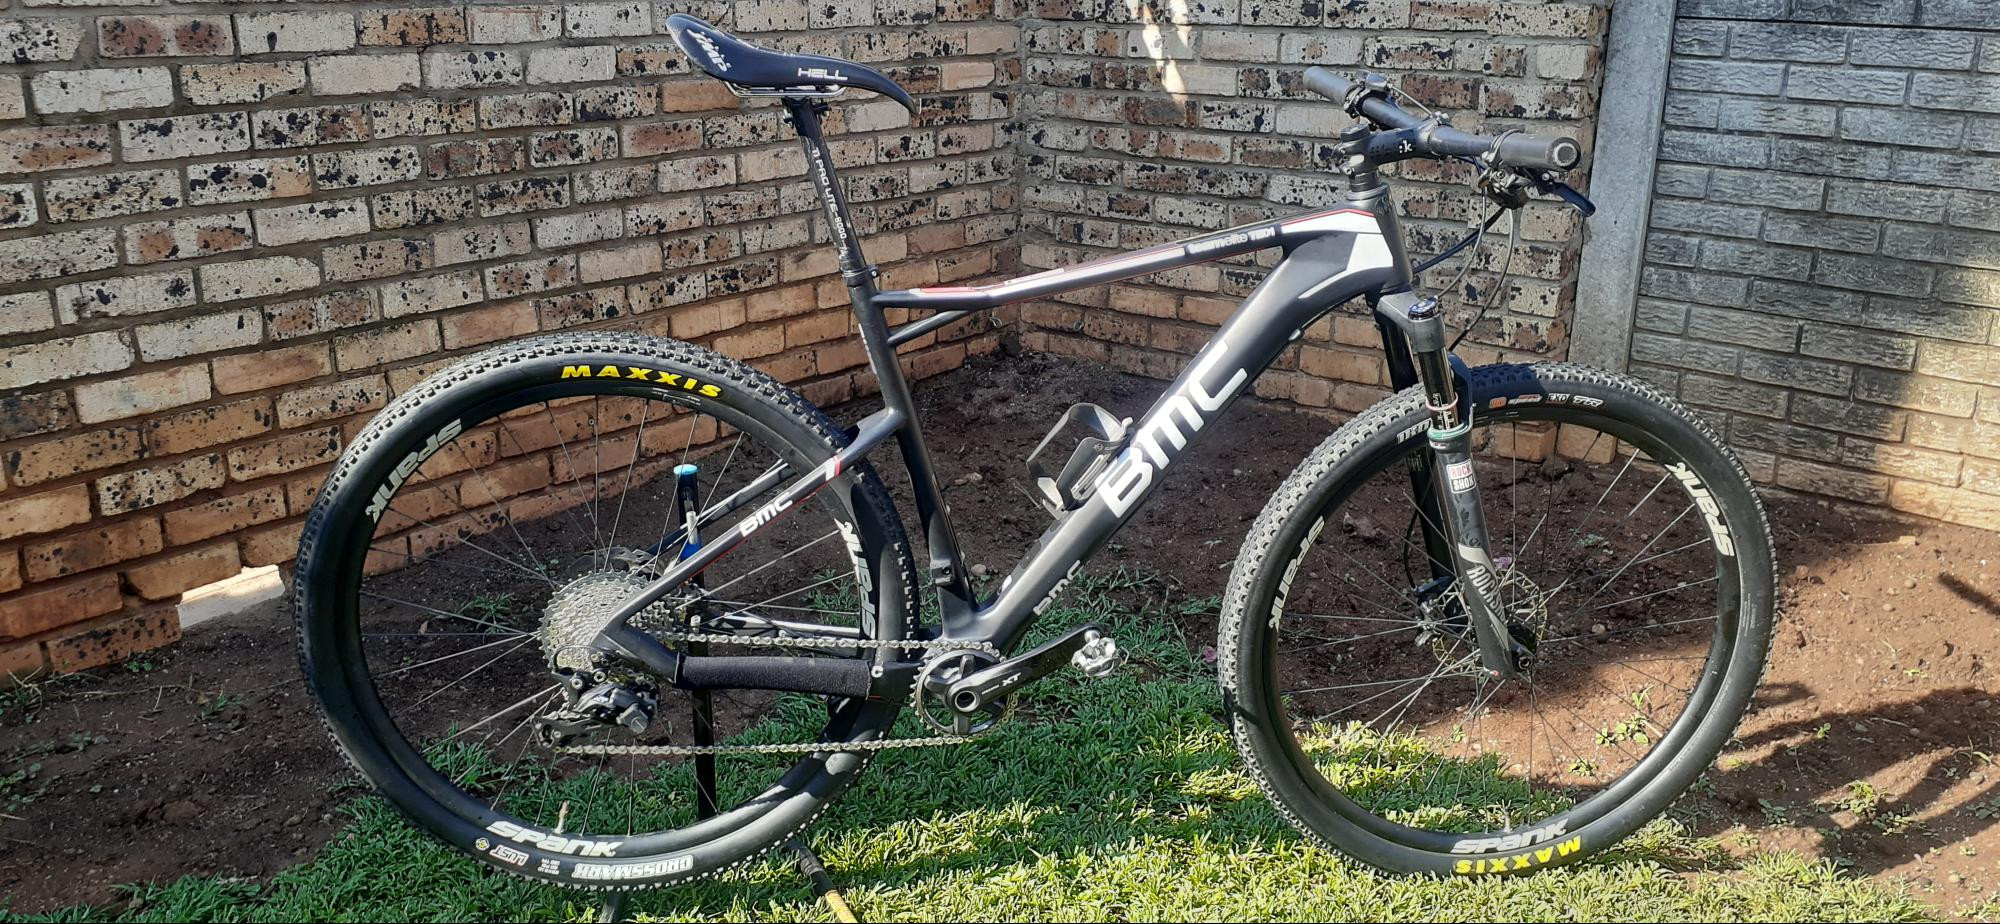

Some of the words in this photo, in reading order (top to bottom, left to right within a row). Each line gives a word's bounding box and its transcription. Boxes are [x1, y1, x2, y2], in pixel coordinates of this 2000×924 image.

[797, 67, 848, 81] HELL
[815, 159, 830, 186] PRO
[560, 365, 723, 398] MAXXIS
[1548, 393, 1570, 404] EXO
[1095, 339, 1248, 518] BMC
[1450, 462, 1474, 478] ROCK
[1452, 475, 1475, 491] SHOX
[739, 492, 793, 537] BMC
[1001, 672, 1022, 687] XT
[489, 844, 530, 867] LUST
[1455, 835, 1581, 874] MAXXIS
[571, 855, 693, 879] CROSSMARK
